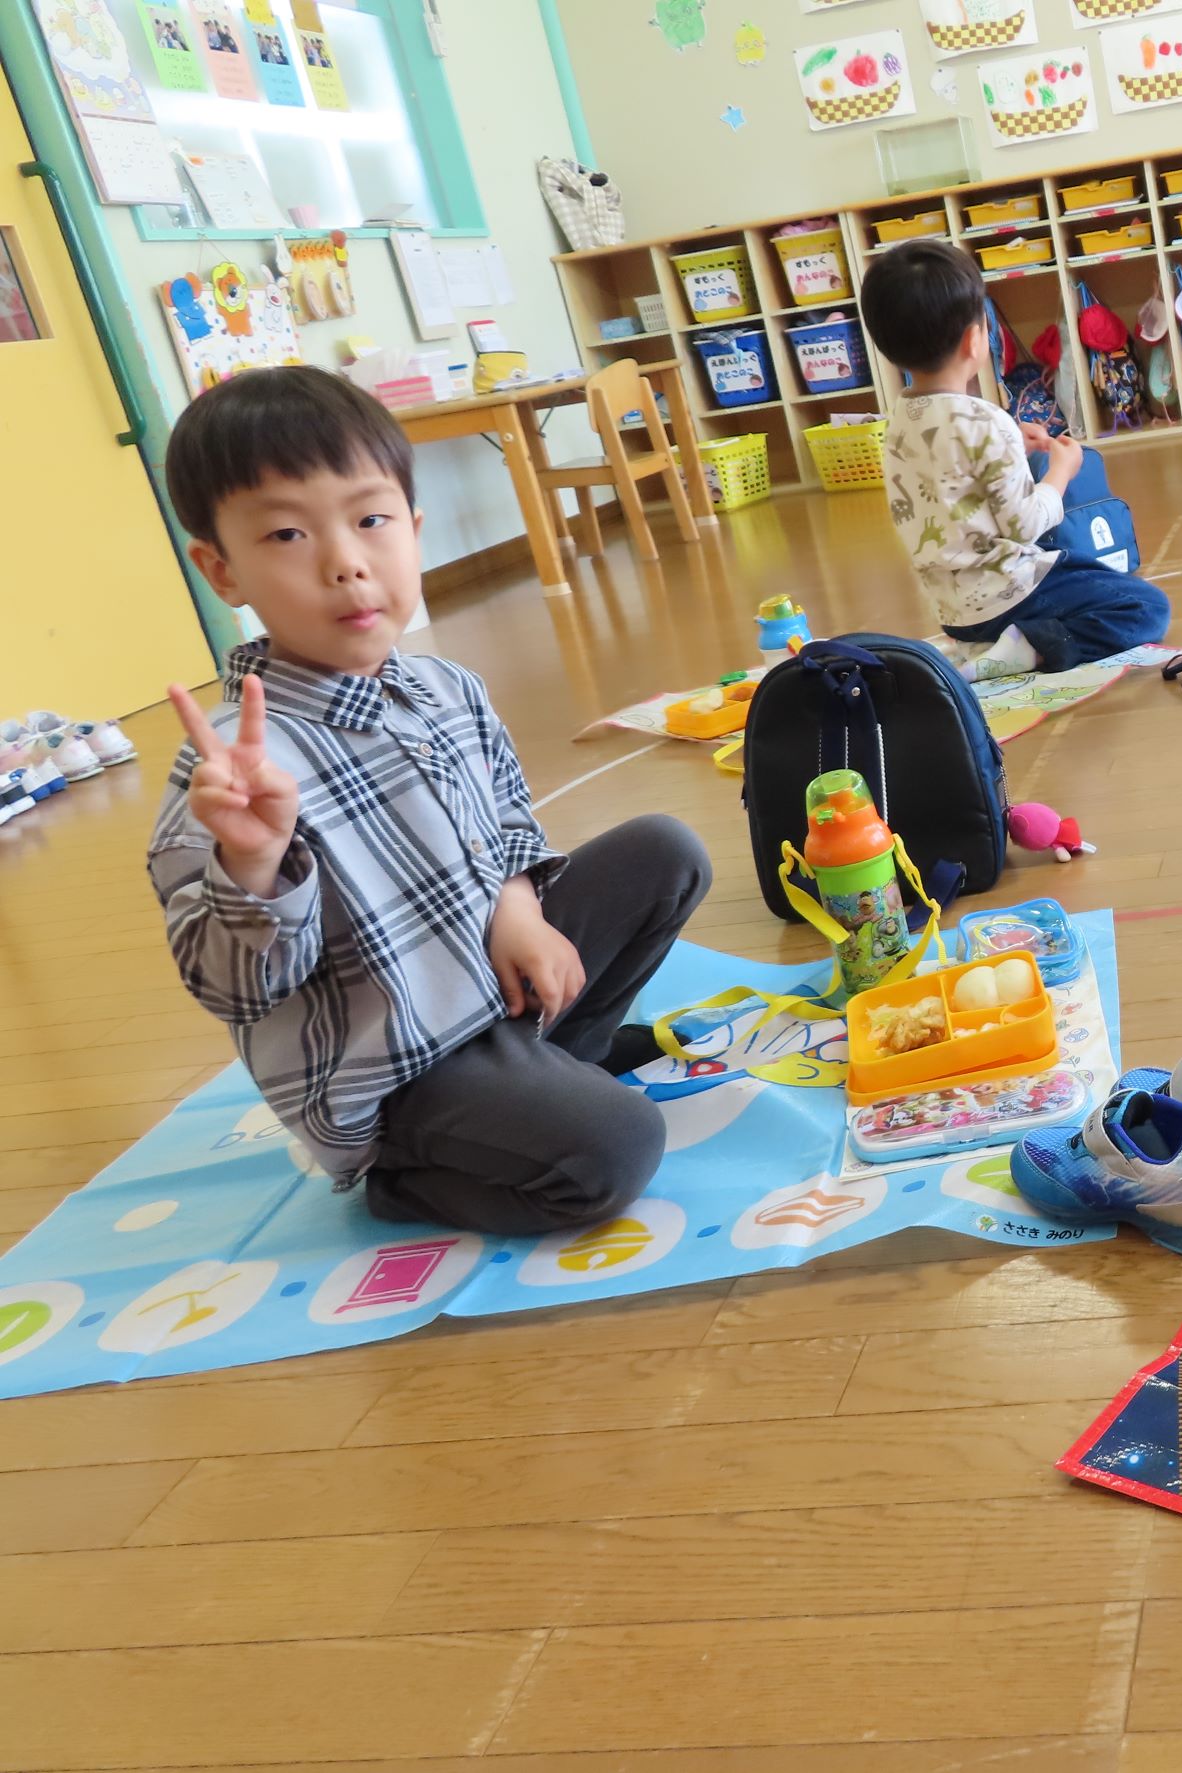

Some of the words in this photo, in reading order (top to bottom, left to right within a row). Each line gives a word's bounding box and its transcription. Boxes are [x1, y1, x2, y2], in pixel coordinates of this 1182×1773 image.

[694, 285, 733, 299] おとこのこ
[801, 343, 846, 356] えほんばっぐ
[716, 367, 753, 380] おとこのこ
[1003, 1221, 1040, 1239] ささき
[1046, 1229, 1085, 1240] みのり
